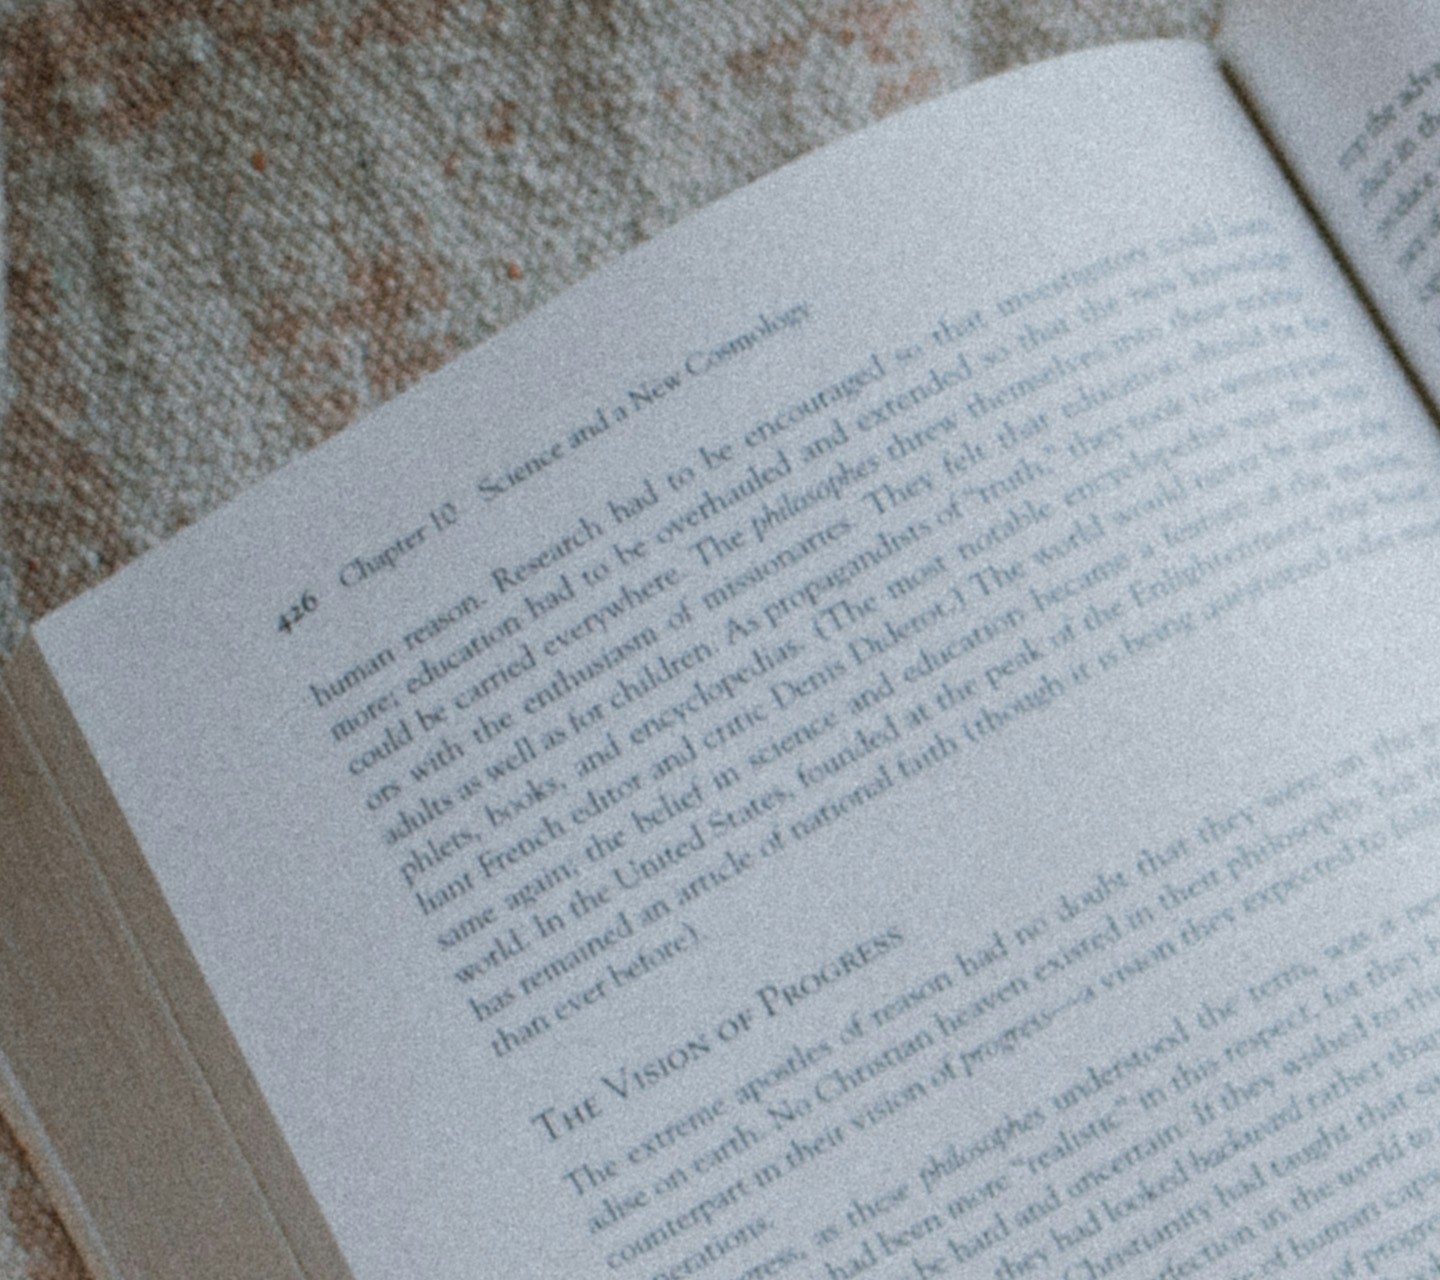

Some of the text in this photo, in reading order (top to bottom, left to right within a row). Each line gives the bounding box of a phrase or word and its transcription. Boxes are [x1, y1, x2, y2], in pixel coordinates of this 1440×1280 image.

[275, 588, 320, 635] 426
[336, 525, 427, 590] Chapter
[427, 498, 459, 533] 10
[474, 441, 565, 504] Science
[567, 406, 612, 450] and
[625, 371, 682, 412] New
[307, 351, 888, 709] human reason. Research had to be encouraged
